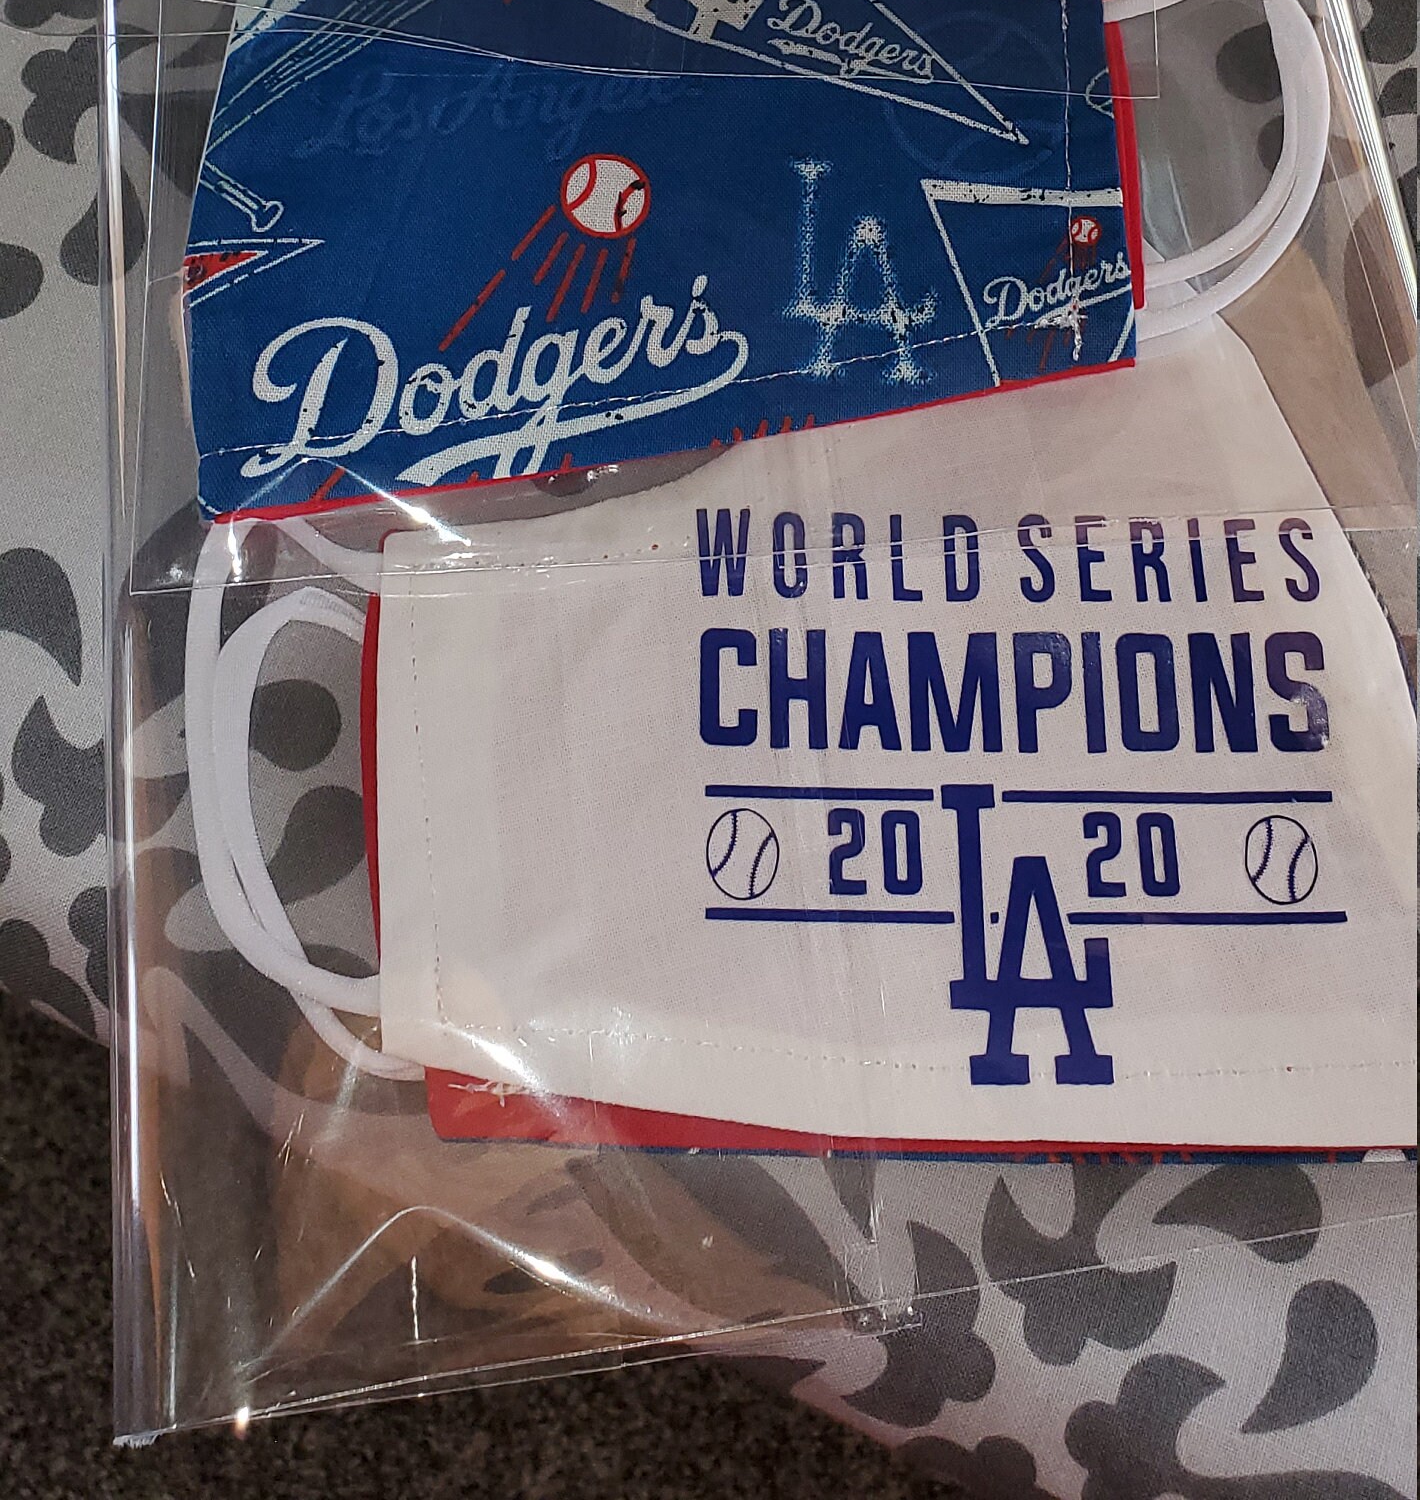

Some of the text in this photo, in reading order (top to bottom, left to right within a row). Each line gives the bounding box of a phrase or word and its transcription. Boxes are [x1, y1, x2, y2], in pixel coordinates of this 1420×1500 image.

[781, 157, 940, 386] LA
[983, 251, 1133, 338] Dodgers
[241, 274, 749, 487] Dodgers
[696, 508, 1322, 603] WORLD SERIES
[699, 627, 1331, 754] CHAMPIONS
[827, 784, 1182, 1086] 20 LA 20
